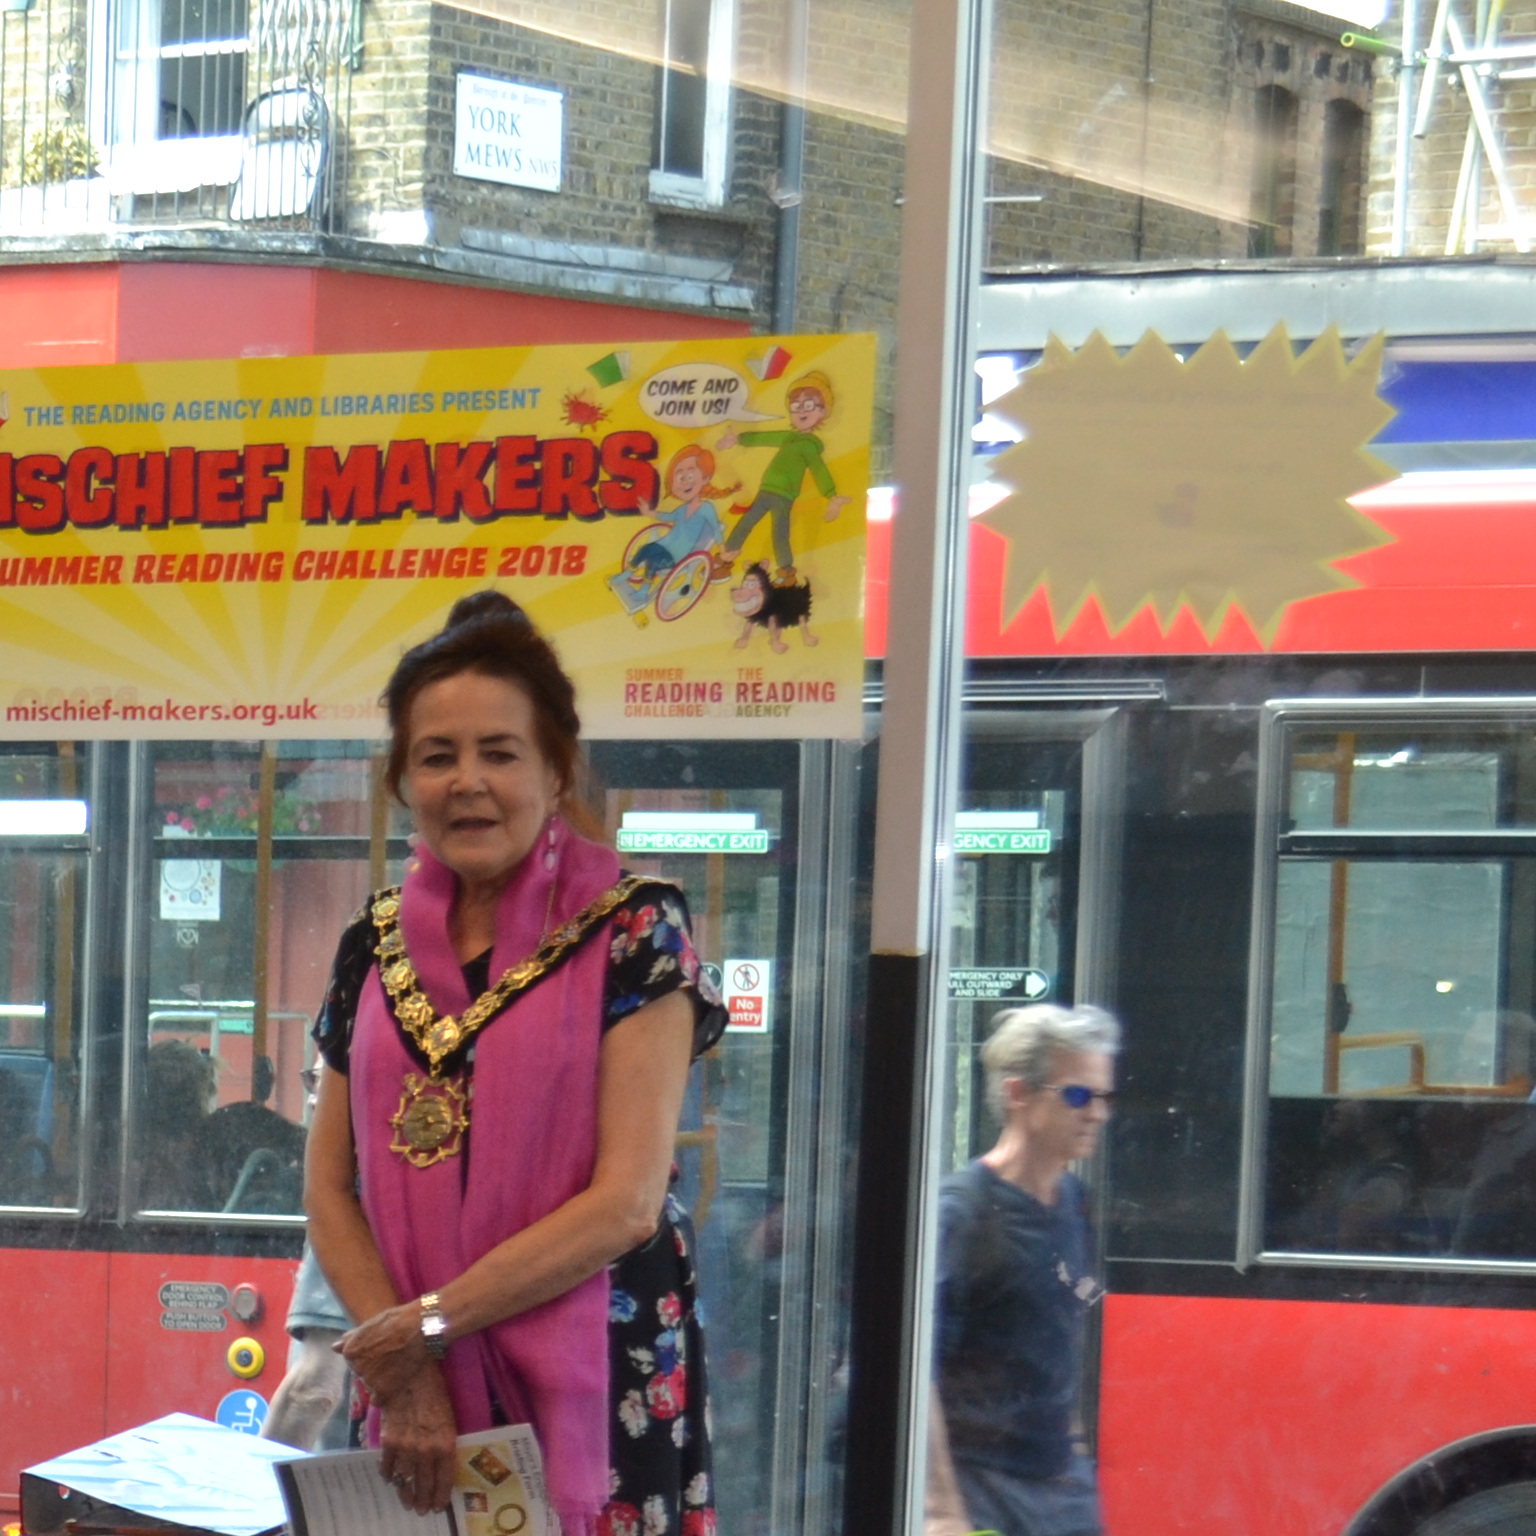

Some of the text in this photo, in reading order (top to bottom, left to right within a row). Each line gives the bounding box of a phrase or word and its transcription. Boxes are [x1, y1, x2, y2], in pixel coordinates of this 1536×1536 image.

[468, 104, 521, 137] YORK
[465, 142, 557, 179] MEWS NW5
[647, 376, 740, 398] COME AND
[24, 387, 542, 428] THE READING AGENCY AND LIBRARIES PRESENT
[654, 396, 731, 417] JOIN US!
[302, 430, 660, 526] MAKERS
[133, 551, 285, 585] READING
[293, 546, 488, 582] CHALLENGE
[497, 545, 588, 578] 2018
[626, 668, 684, 682] SUMMER
[737, 667, 764, 681] THE
[624, 682, 723, 704] READING
[736, 681, 837, 704] READING
[6, 698, 318, 726] mischief-makers.org.uk
[624, 704, 704, 718] CHALLENGE
[736, 704, 792, 718] AGENCY
[635, 834, 765, 849] EMERGENCY EXIT
[1011, 834, 1046, 848] EXIT
[999, 973, 1024, 981] ONLY
[966, 981, 1012, 990] OUTWARD
[955, 989, 1000, 997] AND SLIDE
[736, 999, 755, 1010] No
[729, 1011, 761, 1024] entry
[170, 1285, 216, 1293] EMERGENCY
[162, 1291, 224, 1302] DOOR CONTROL
[198, 1301, 218, 1309] FLAP
[166, 1312, 220, 1322] PUSH BUTTON
